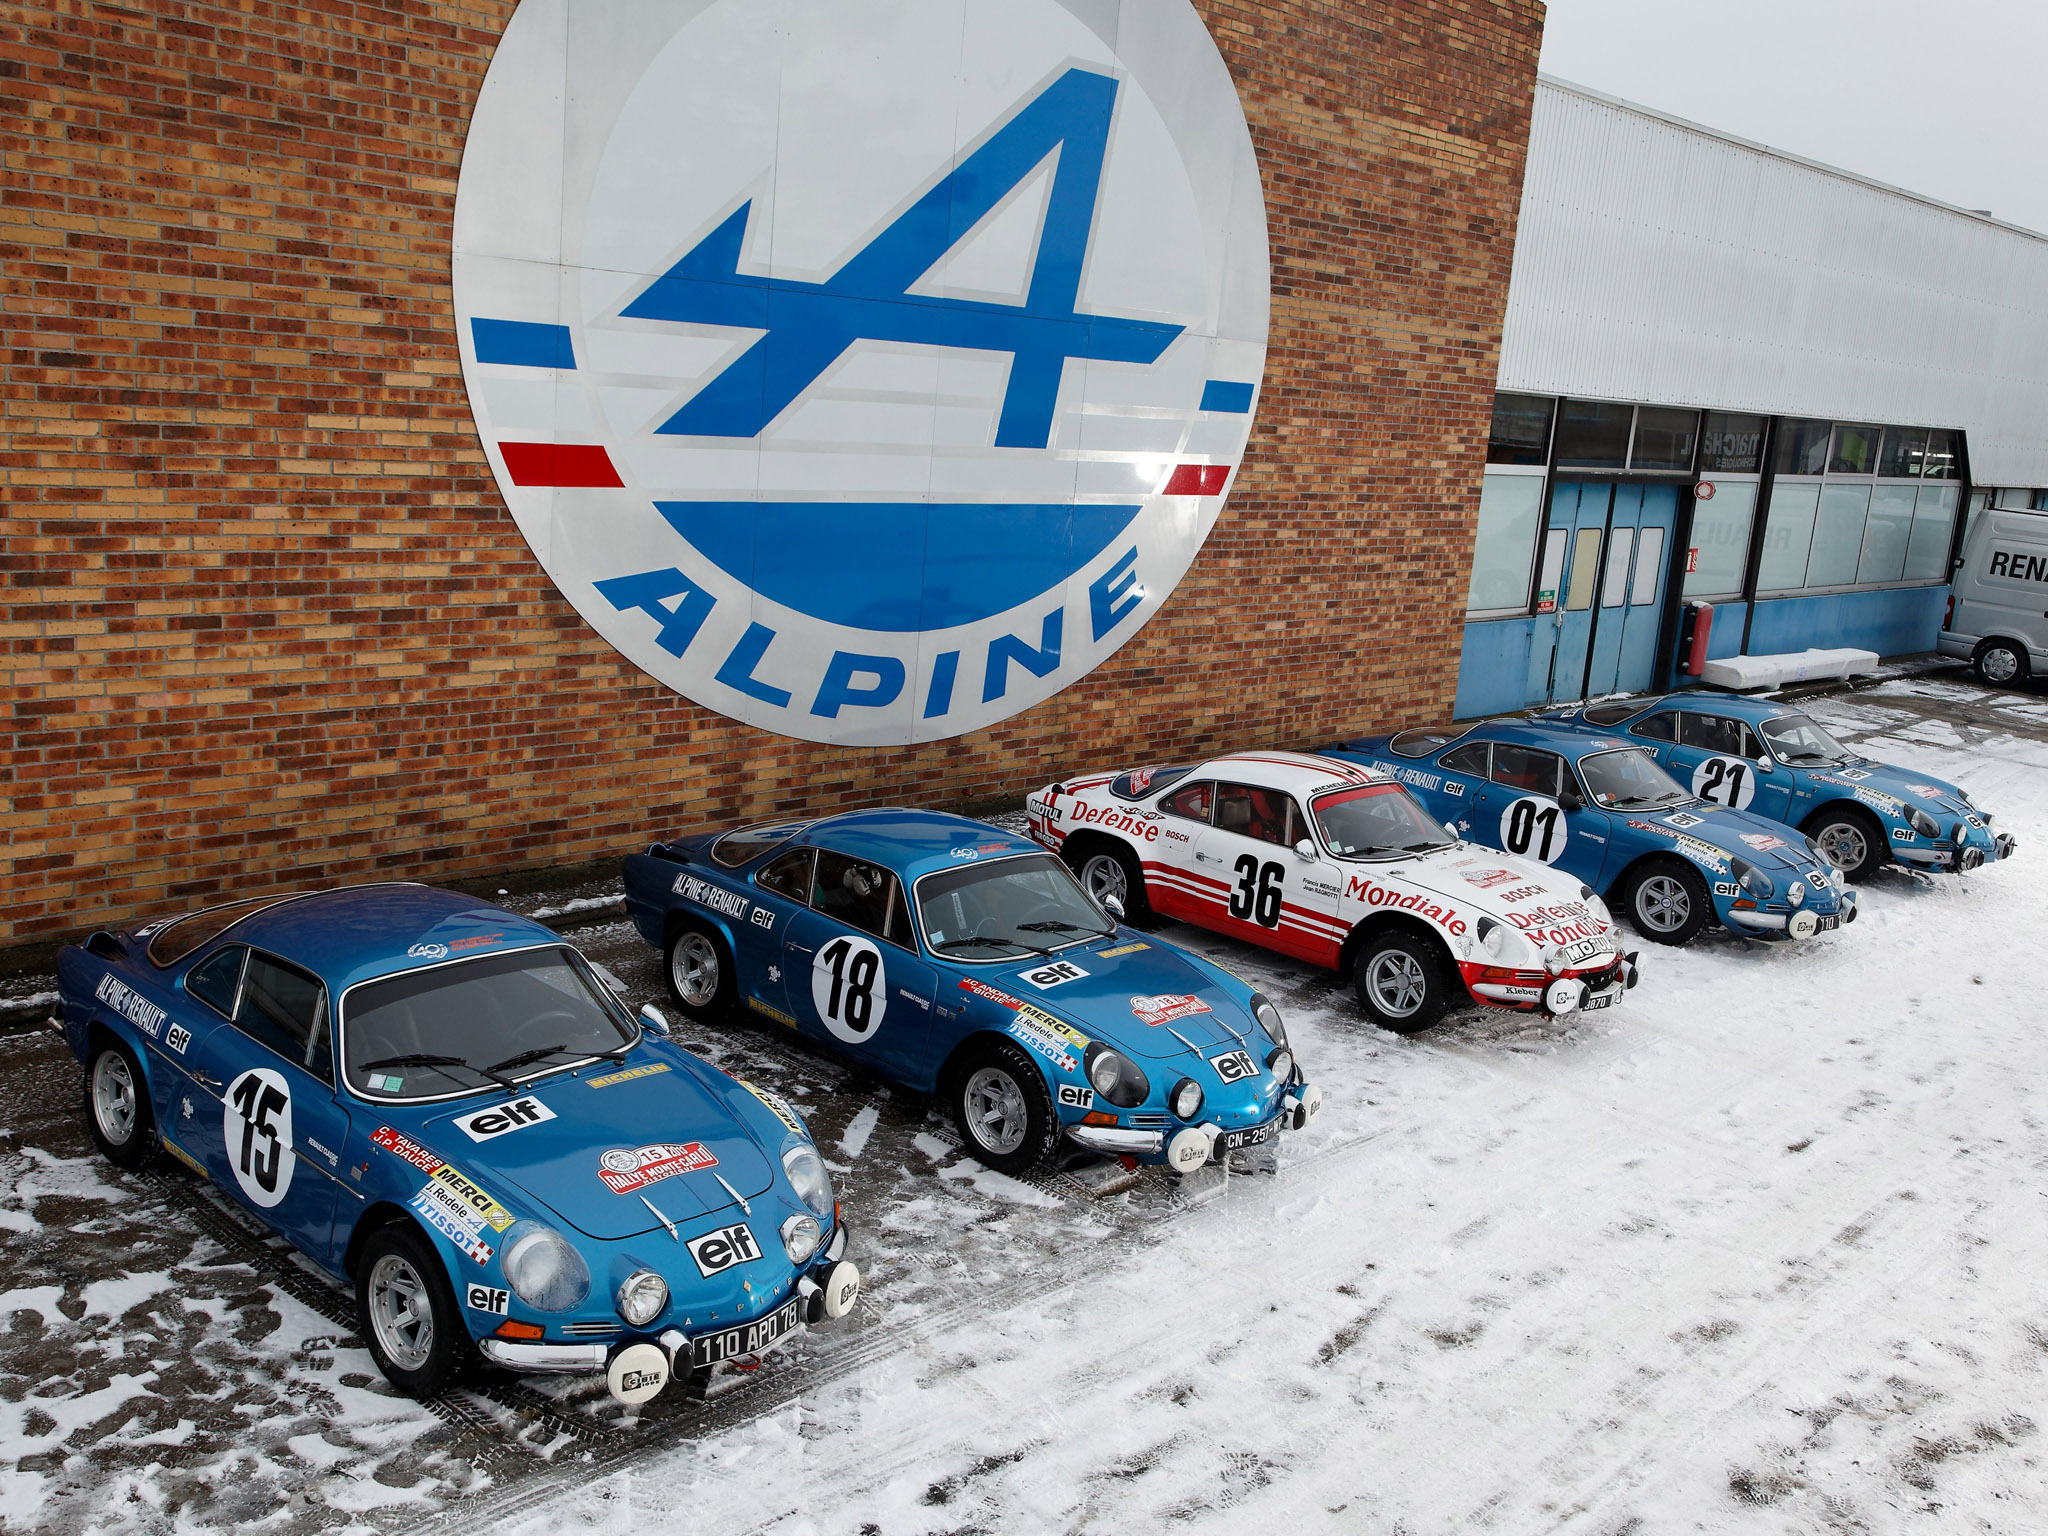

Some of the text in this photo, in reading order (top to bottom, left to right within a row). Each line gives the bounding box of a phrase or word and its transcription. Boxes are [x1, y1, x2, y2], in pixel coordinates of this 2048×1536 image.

[1989, 551, 2048, 582] REN
[592, 545, 1147, 719] ALPINE
[1311, 781, 1351, 793] MICHELIN
[1371, 760, 1442, 791] ALPINE RENAULT
[1446, 782, 1464, 795] elf
[1699, 759, 1747, 808] 21
[1030, 801, 1062, 821] MOTUL
[1070, 800, 1159, 843] Defense
[1034, 830, 1055, 847] FERODO
[1165, 829, 1190, 843] BOSCH
[1507, 800, 1559, 862] 01
[1680, 835, 1718, 853] MERCI
[1893, 829, 1915, 841] elf
[1684, 850, 1718, 868] TISSOT
[672, 874, 748, 919] ALPINE RENAULT
[1229, 853, 1286, 929] 36
[1500, 884, 1548, 903] BOSCH
[1715, 883, 1739, 897] elf
[753, 910, 774, 928] elf
[1344, 876, 1467, 937] Mondiale
[1565, 936, 1613, 964] MOTUL
[822, 938, 879, 1034] 18
[1031, 963, 1079, 985] elf
[96, 975, 166, 1039] ALPINE RENAULT
[963, 978, 1025, 1006] J.C ANDRUET
[1505, 987, 1539, 997] Kleber
[1022, 1006, 1071, 1036] MERCI
[1023, 1018, 1054, 1040] Redele
[168, 1027, 190, 1052] elf
[1019, 1030, 1063, 1062] TISSOT
[590, 1063, 670, 1087] MICHELIN
[1218, 1051, 1255, 1079] elf
[1061, 1088, 1093, 1108] elf
[470, 1099, 540, 1134] elf
[233, 1073, 288, 1193] 15
[378, 1125, 444, 1168] C. TAVARES
[373, 1135, 434, 1173] J.P DAUCE
[604, 1170, 648, 1191] RALLYE
[645, 1145, 714, 1178] MONTE-CARLO
[640, 1148, 663, 1162] 15
[665, 1145, 689, 1158] 2013
[425, 1182, 434, 1195] J.
[433, 1187, 468, 1219] Redele
[436, 1168, 494, 1213] MERCI
[423, 1205, 477, 1251] TISSOT
[697, 1225, 755, 1270] elf
[469, 1287, 508, 1314] elf
[685, 1276, 793, 1327] ALPINE
[701, 1302, 798, 1364] 110 APD 78
